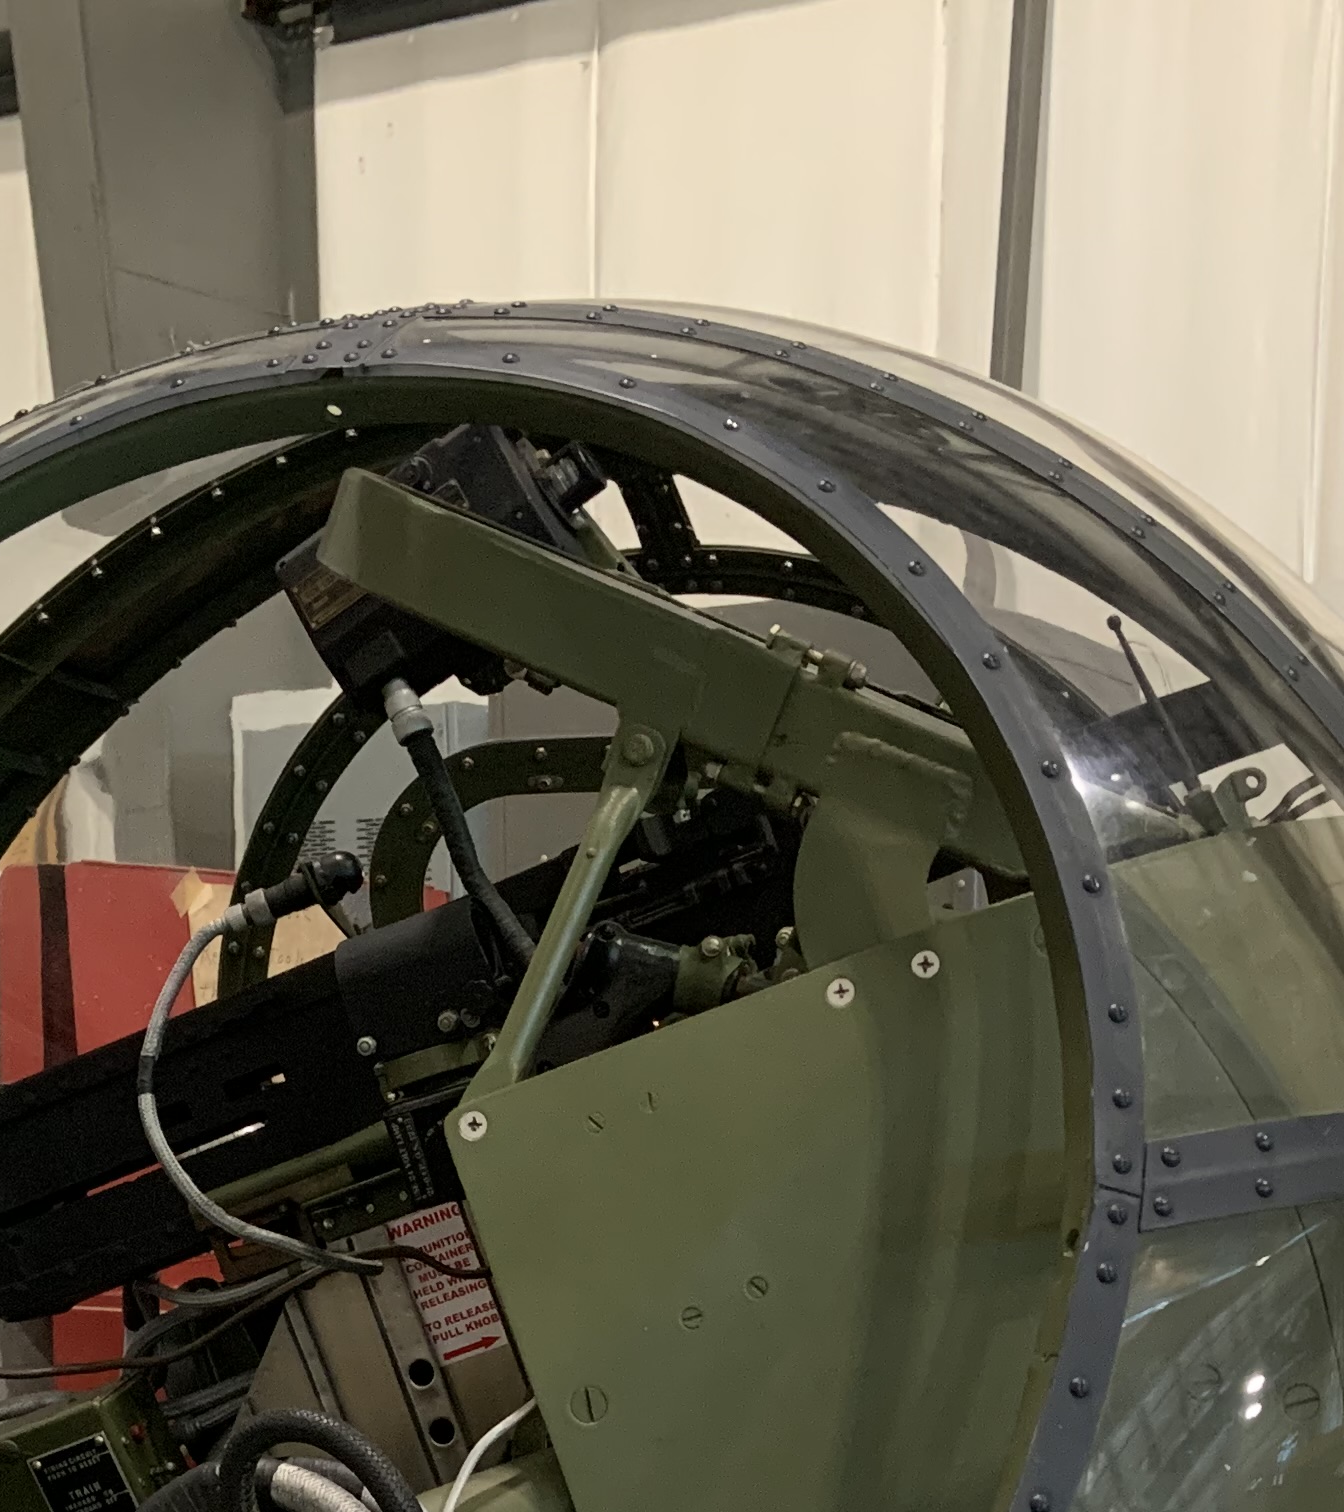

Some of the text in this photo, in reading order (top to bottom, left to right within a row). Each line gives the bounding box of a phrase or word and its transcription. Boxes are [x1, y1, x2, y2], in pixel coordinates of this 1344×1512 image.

[413, 1281, 444, 1299] HELD
[420, 1279, 488, 1311] RELEASING
[425, 1301, 497, 1333] TO RELEASE
[432, 1313, 500, 1345] PULL KNOB
[68, 1481, 102, 1500] TRAIN
